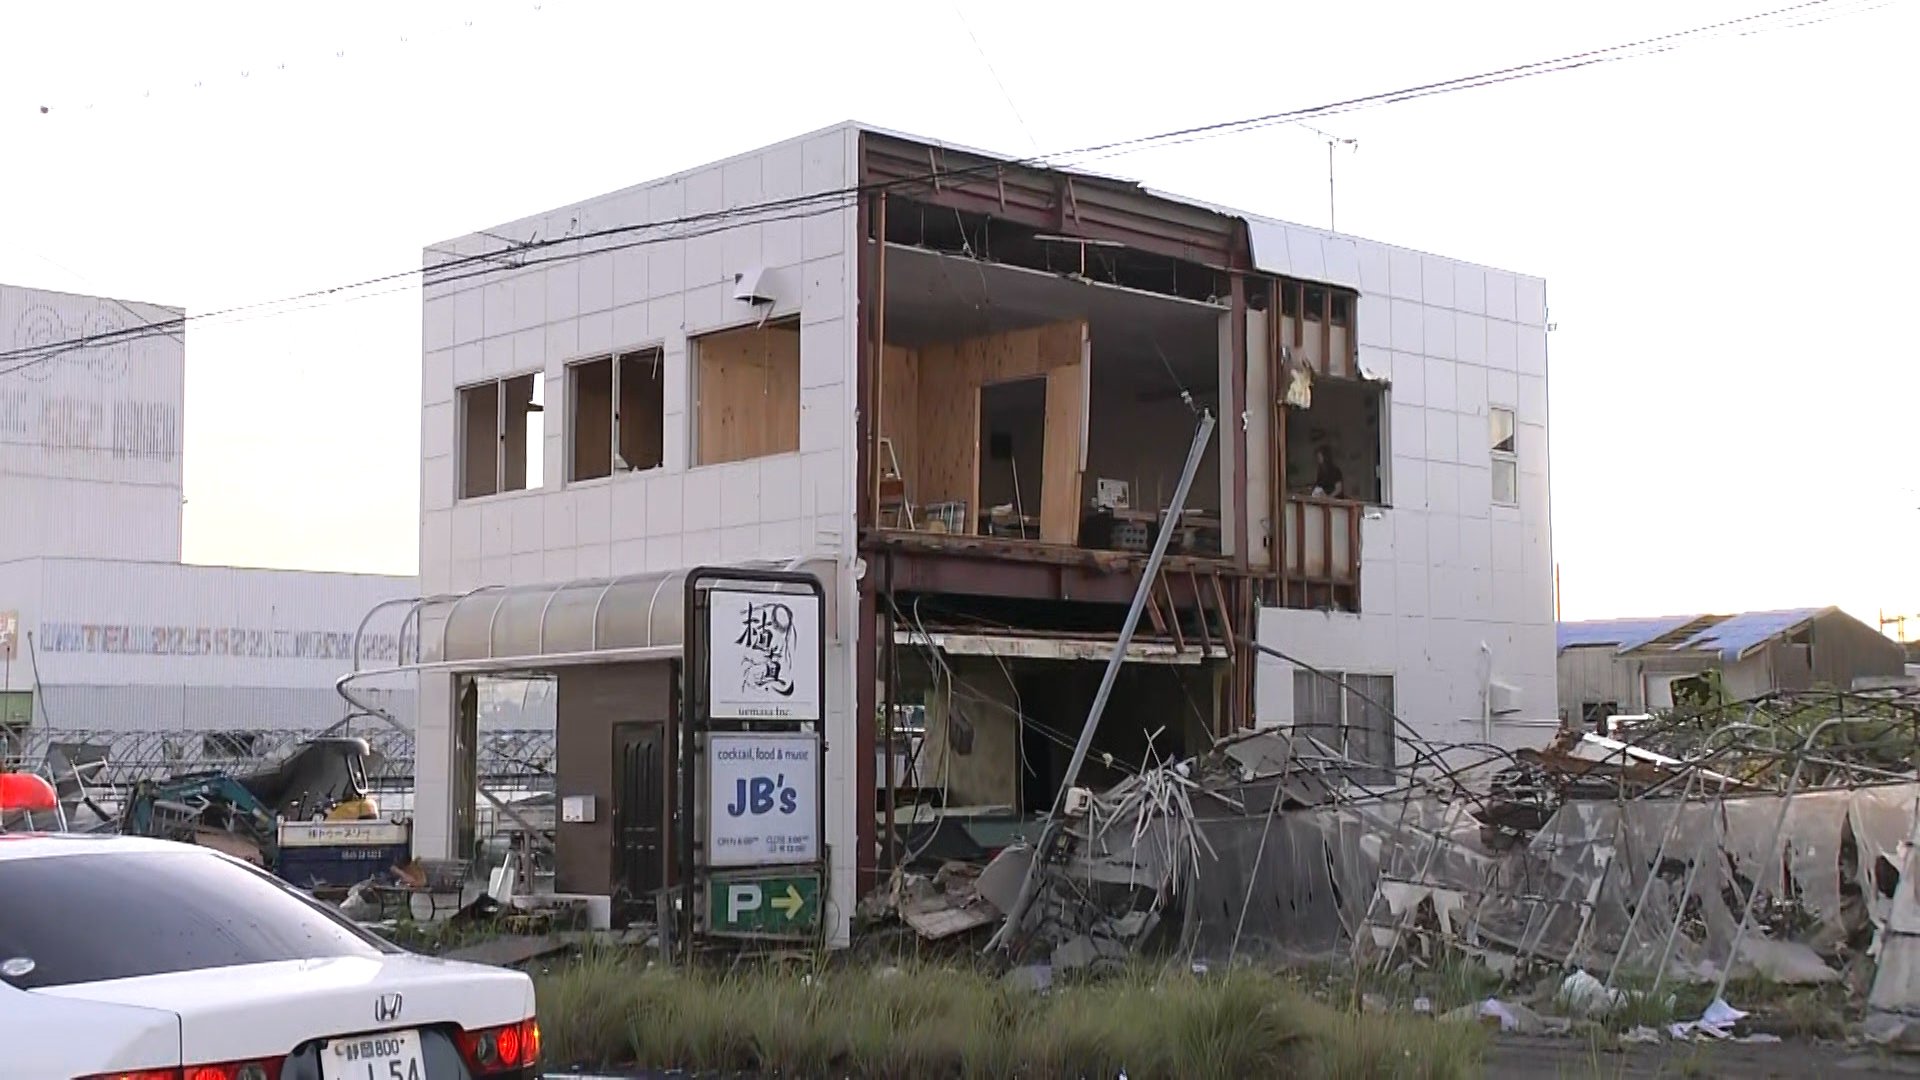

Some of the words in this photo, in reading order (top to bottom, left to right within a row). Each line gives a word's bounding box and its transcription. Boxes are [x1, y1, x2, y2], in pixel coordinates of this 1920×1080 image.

[756, 747, 775, 761] food
[785, 751, 808, 760] music
[727, 773, 797, 817] JB's
[728, 885, 762, 922] P
